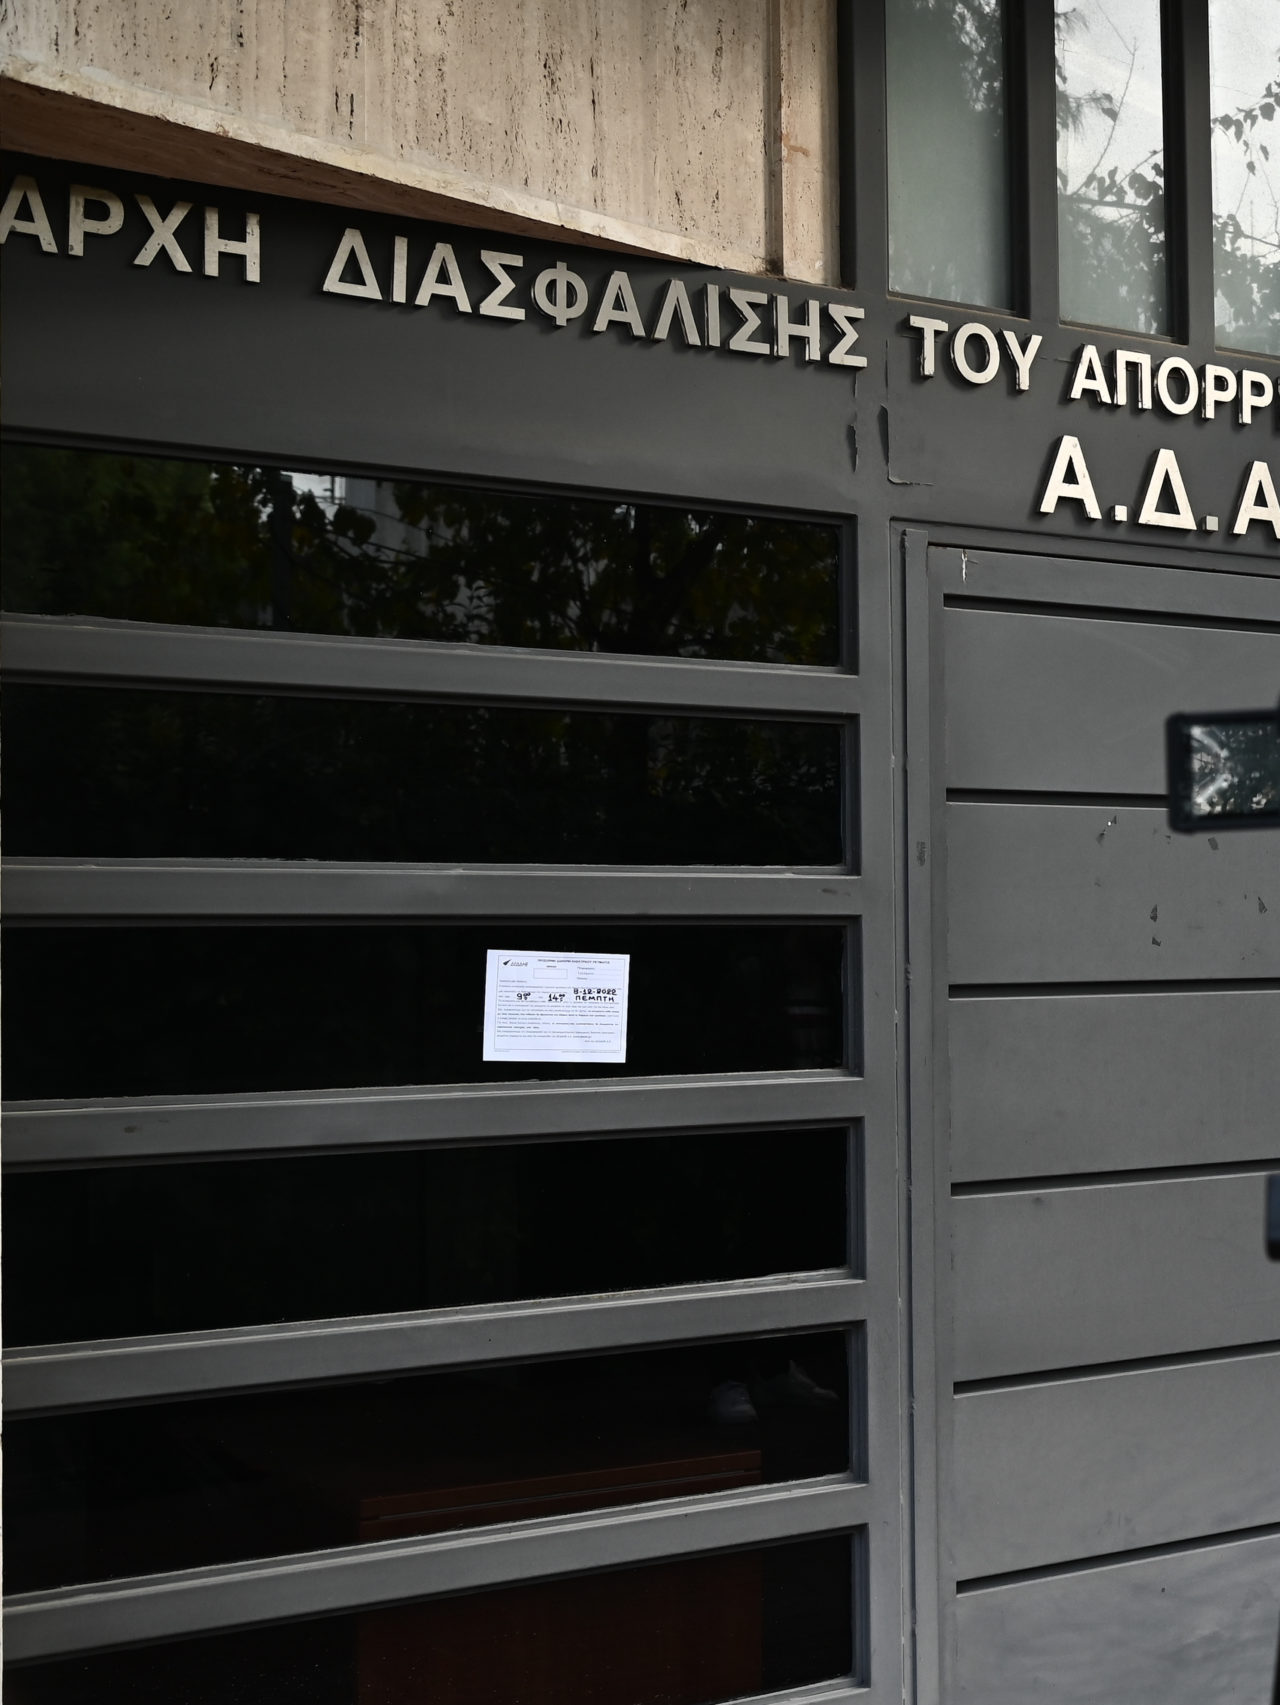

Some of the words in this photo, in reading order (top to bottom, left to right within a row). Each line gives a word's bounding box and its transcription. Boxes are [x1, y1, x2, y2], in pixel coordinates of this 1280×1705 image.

[0, 175, 262, 284] ΑΡΧΗ
[322, 227, 868, 369] ΔΙΑΣΦΑΛΙΣΗΣ
[909, 313, 1043, 392] ΤΟΥ
[575, 995, 615, 1003] ΠΕΜΠΤΗ
